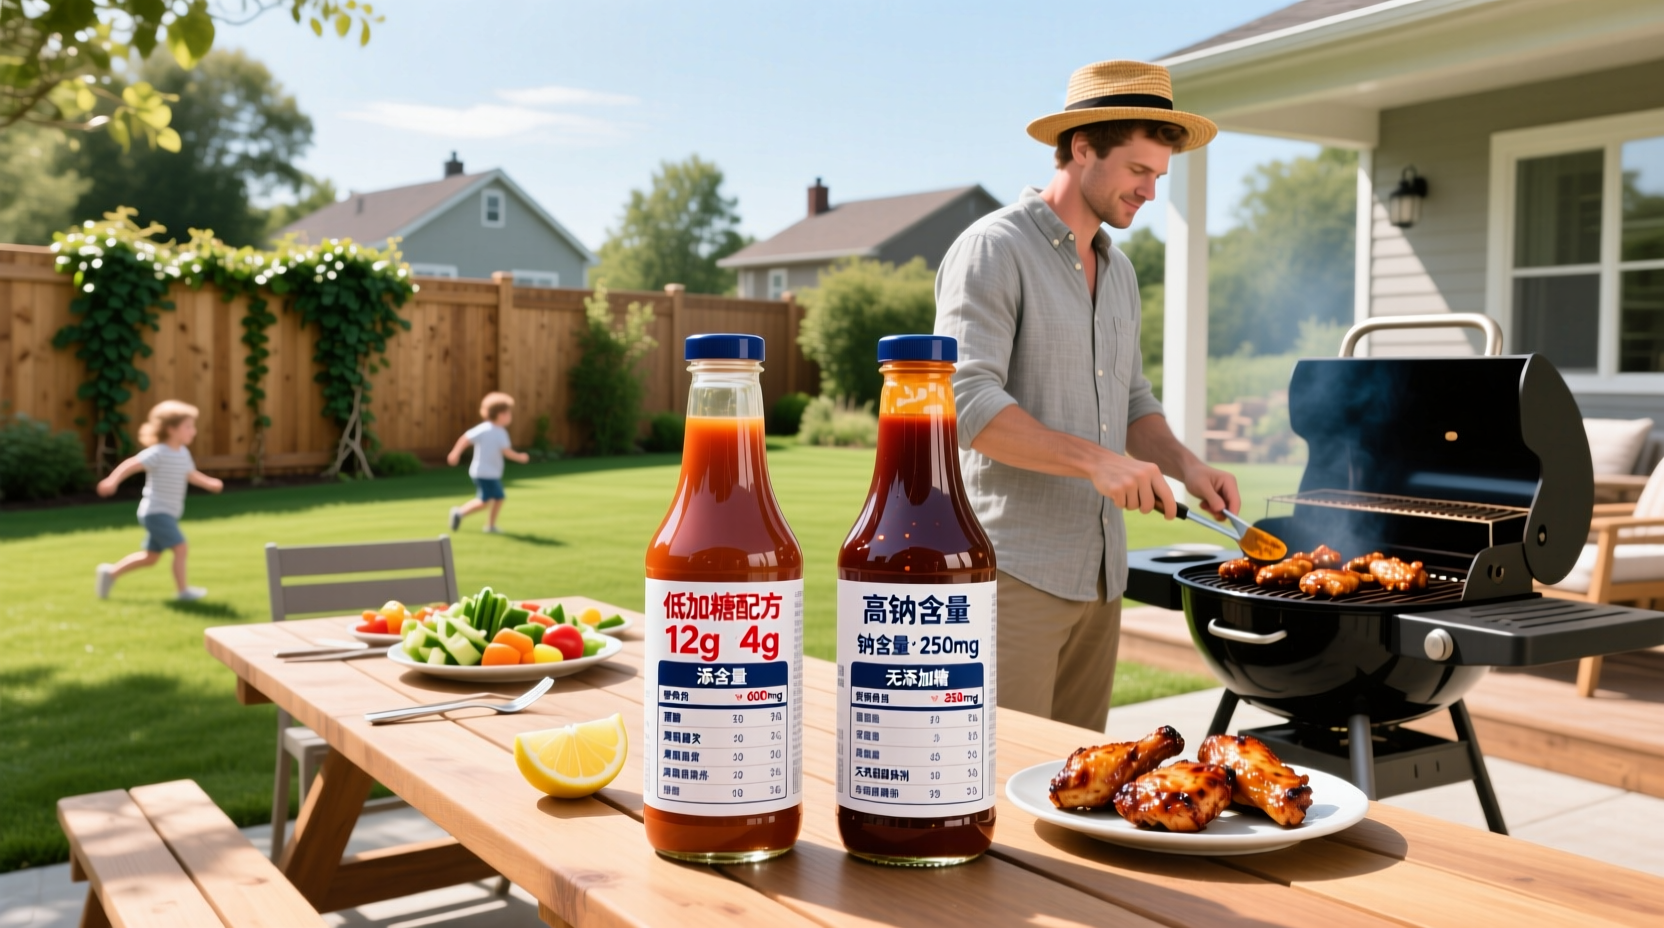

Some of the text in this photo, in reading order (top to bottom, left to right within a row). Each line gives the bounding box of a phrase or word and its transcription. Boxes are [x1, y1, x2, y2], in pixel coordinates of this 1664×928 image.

[663, 591, 783, 621] 低加糖配方
[862, 594, 971, 625] 高钠含量
[665, 624, 780, 662] 12g 4g
[747, 690, 783, 702] 600mg
